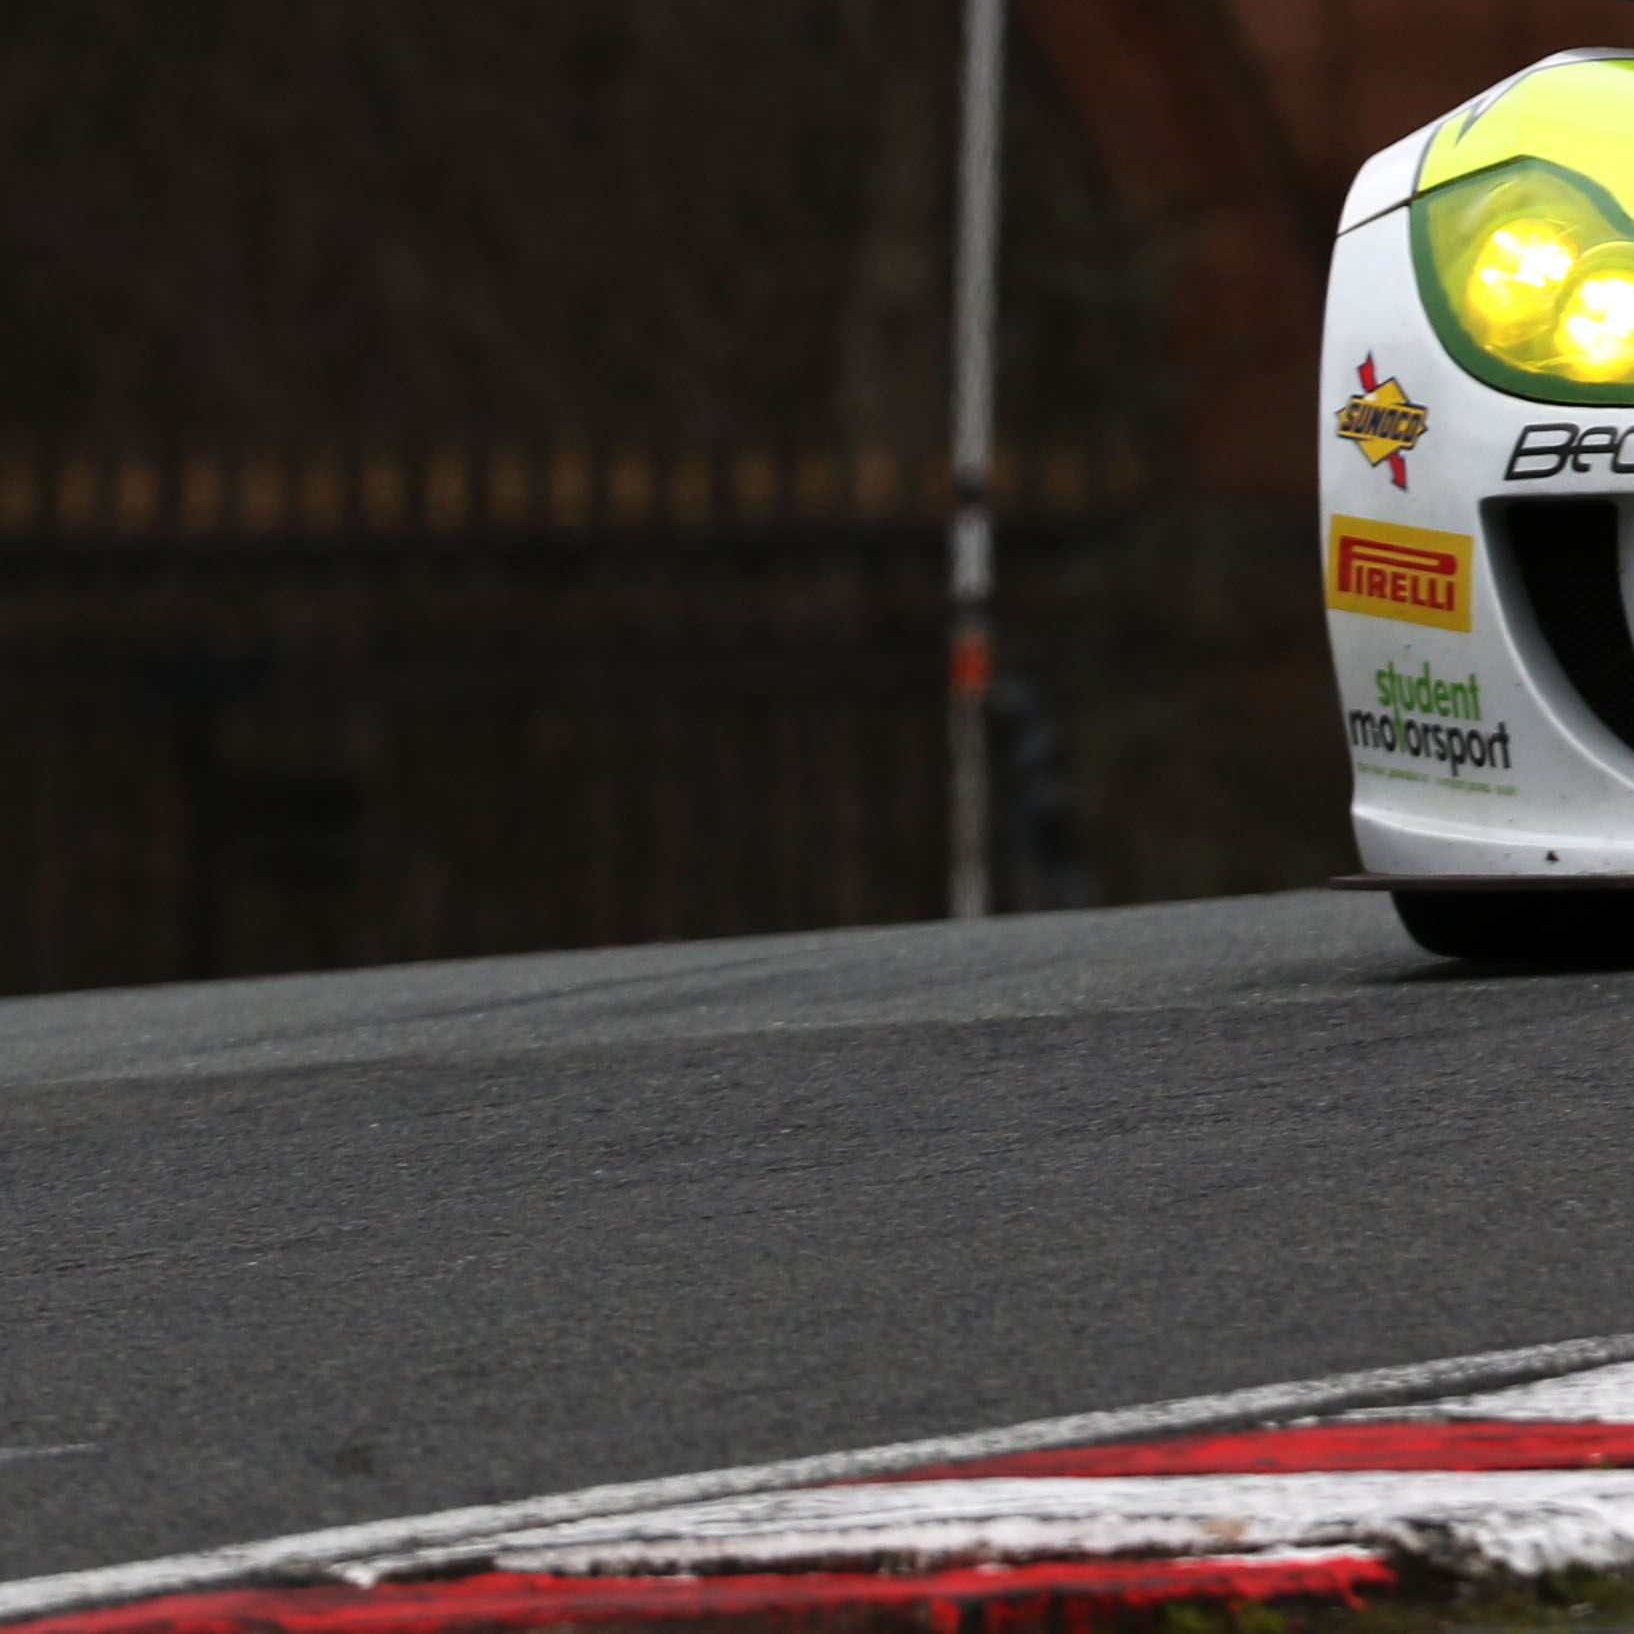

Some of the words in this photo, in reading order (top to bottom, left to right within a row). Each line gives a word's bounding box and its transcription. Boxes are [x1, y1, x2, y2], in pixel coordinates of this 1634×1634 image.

[1336, 535, 1458, 612] PIRELLI
[1375, 660, 1483, 722] student
[1348, 708, 1512, 778] motorsport
